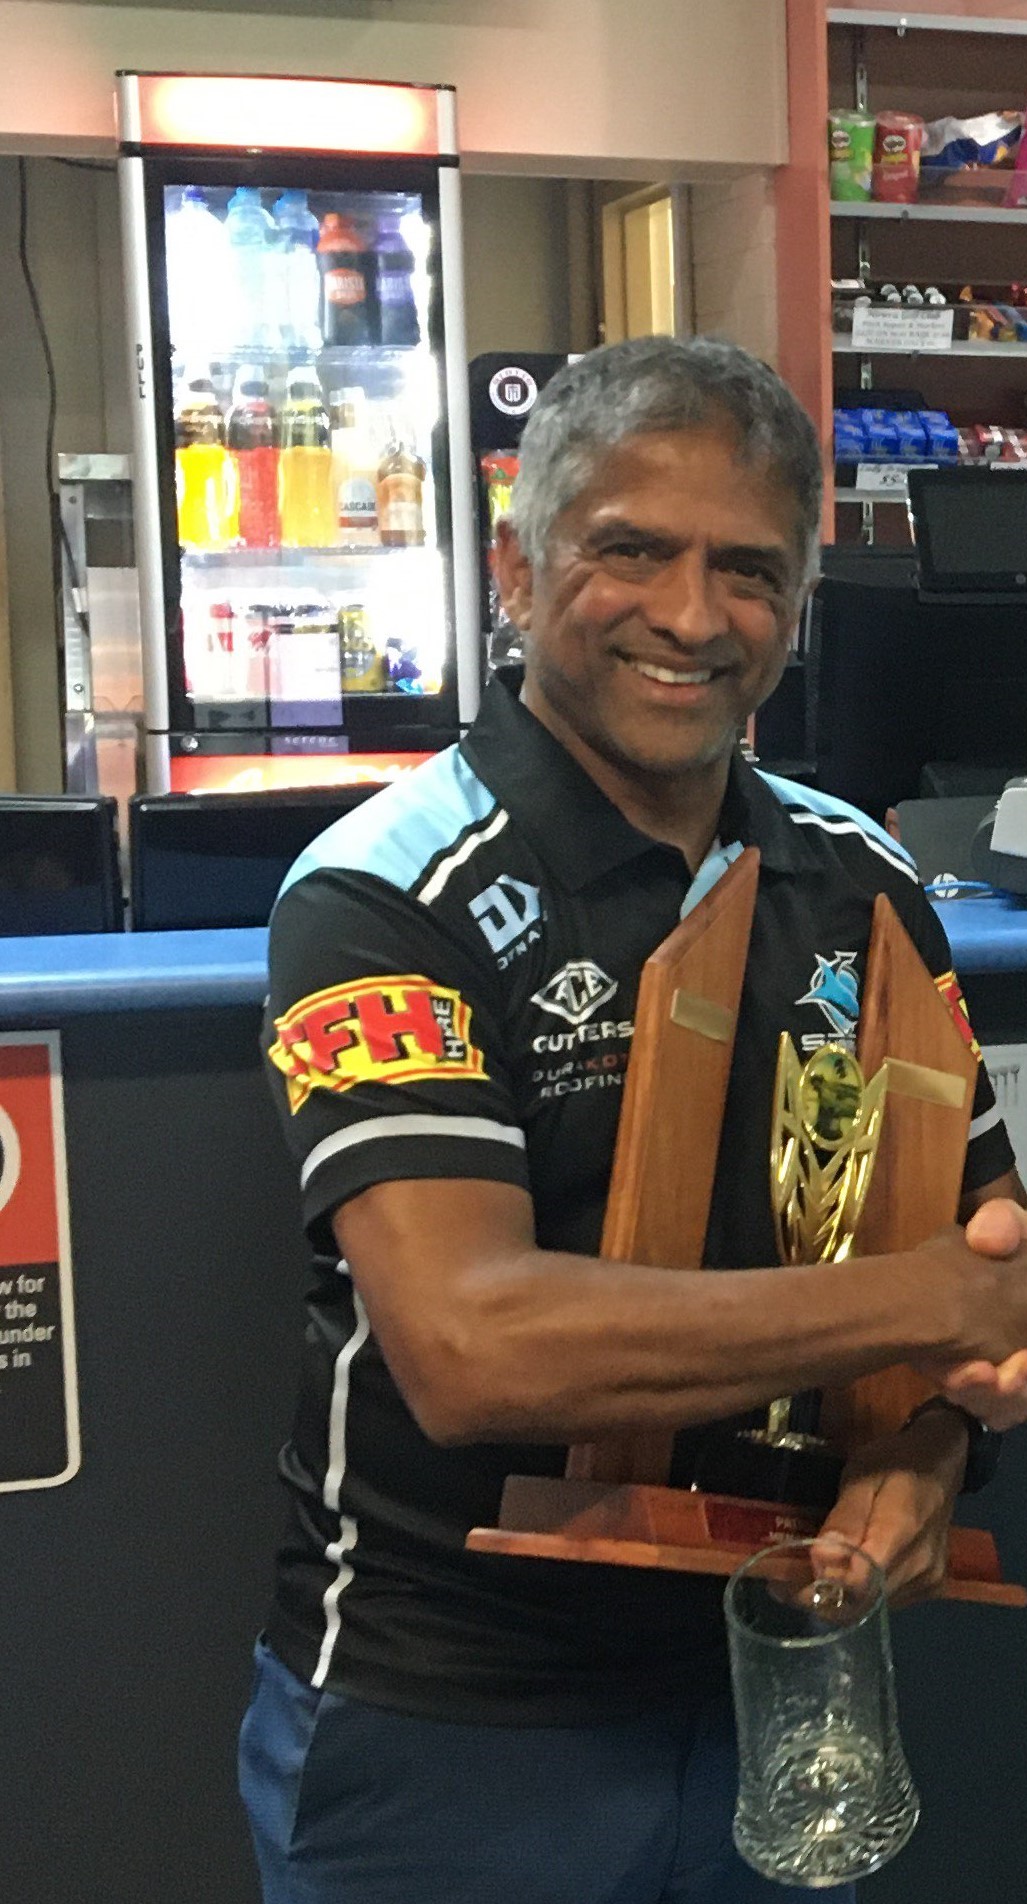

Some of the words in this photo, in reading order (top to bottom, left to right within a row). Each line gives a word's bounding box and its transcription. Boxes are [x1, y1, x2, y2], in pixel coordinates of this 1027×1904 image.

[136, 343, 146, 399] PULL
[540, 1074, 622, 1098] ROOFIN
[17, 1275, 46, 1294] for
[4, 1300, 38, 1320] the
[12, 1347, 32, 1368] in
